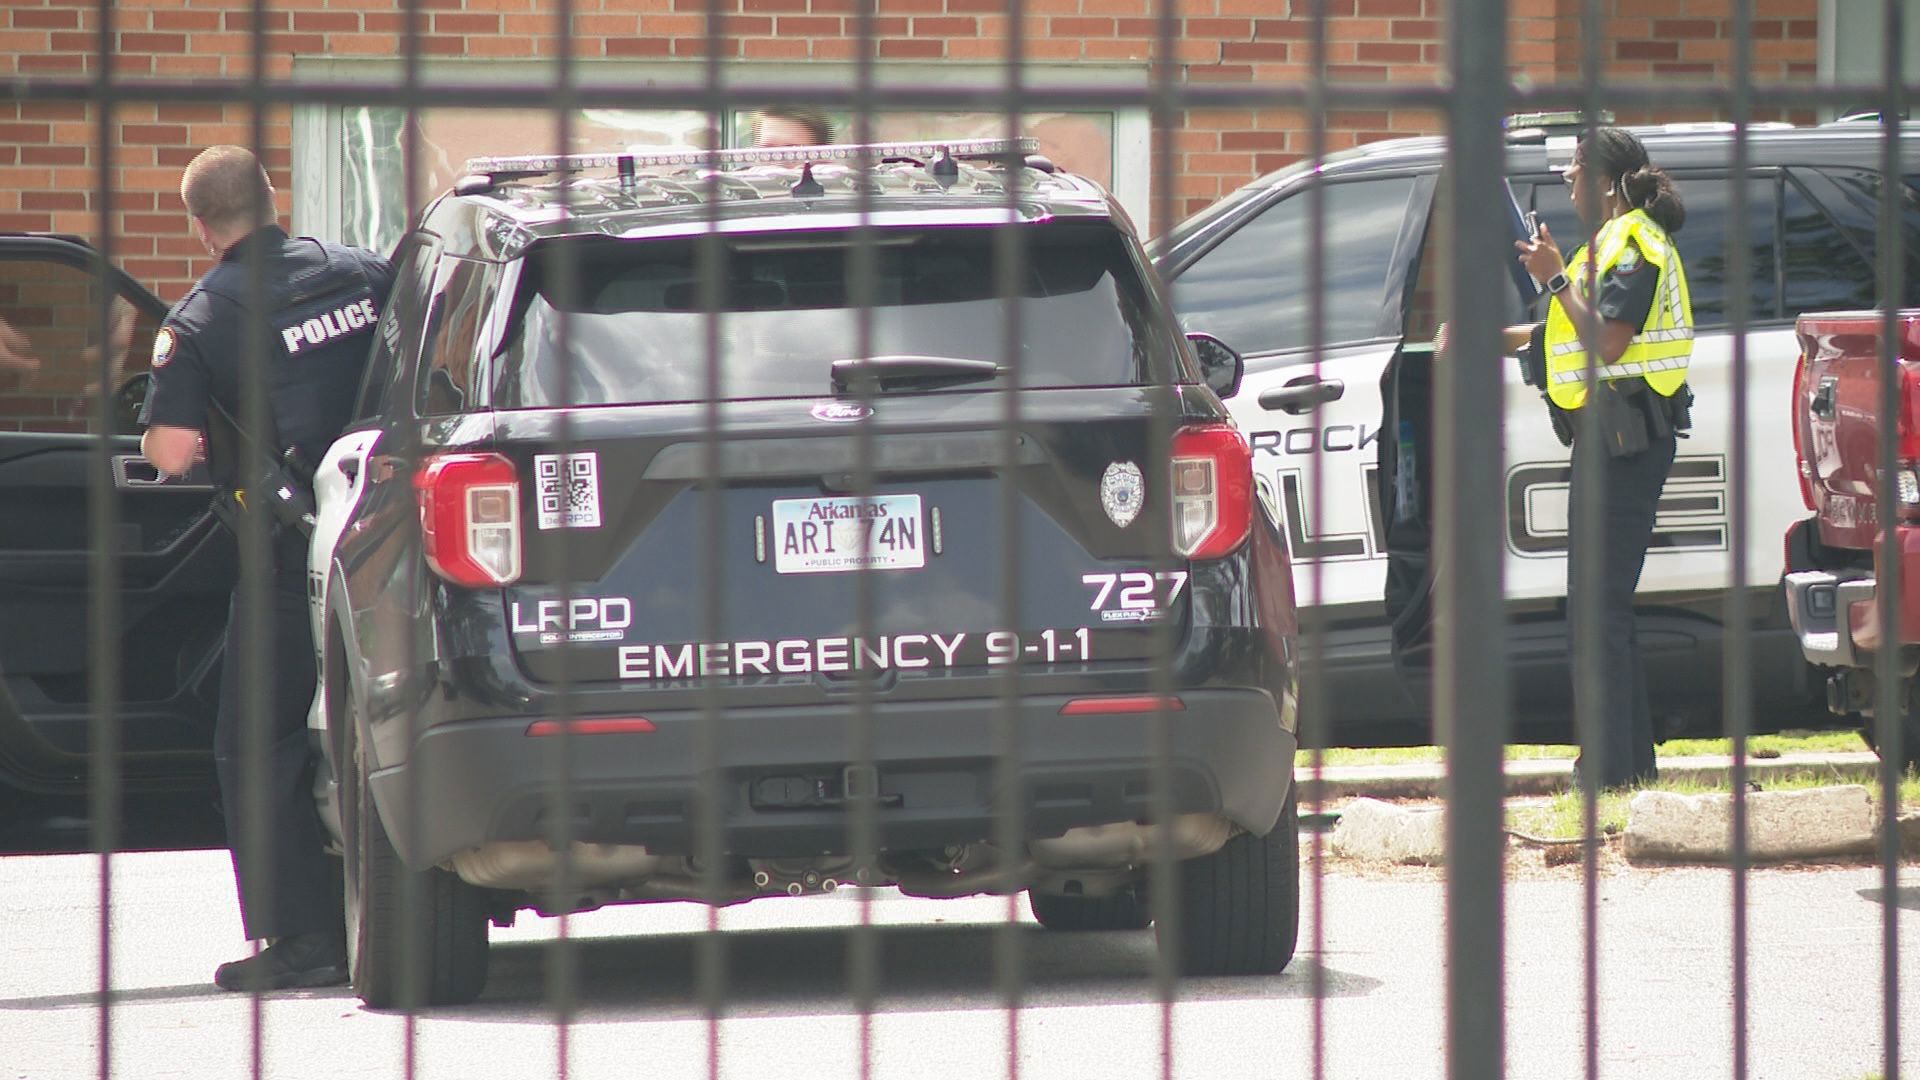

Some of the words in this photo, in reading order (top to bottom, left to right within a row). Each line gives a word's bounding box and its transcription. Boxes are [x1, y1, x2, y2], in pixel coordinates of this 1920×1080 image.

[281, 299, 378, 353] POLICE
[828, 403, 862, 417] Ford
[1250, 424, 1379, 457] ROCK
[808, 501, 887, 519] Arkanas
[784, 520, 836, 555] ARI
[861, 516, 916, 553] 74N
[811, 558, 841, 566] PUBLIC
[843, 555, 888, 564] PRORTY
[1082, 571, 1188, 610] 727
[512, 598, 631, 633] LRPD
[618, 633, 965, 679] EMERGENCY
[986, 628, 1089, 664] 9-1-1
